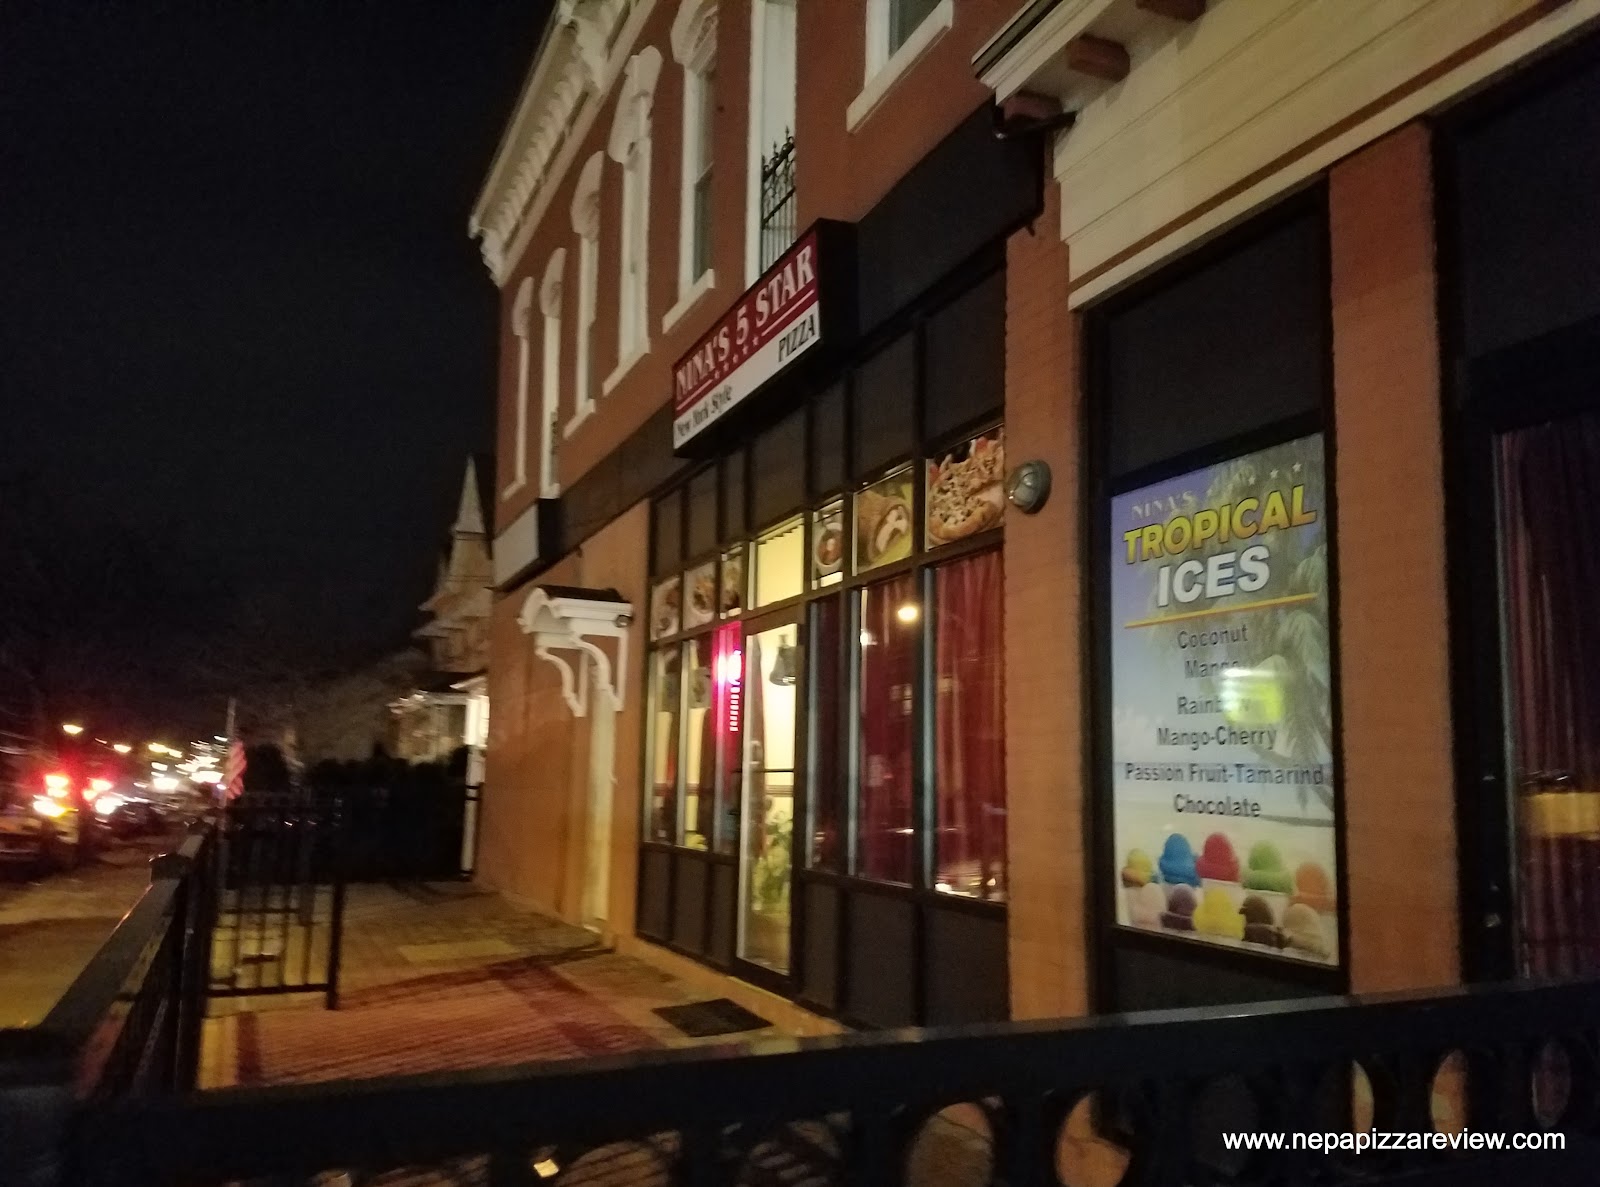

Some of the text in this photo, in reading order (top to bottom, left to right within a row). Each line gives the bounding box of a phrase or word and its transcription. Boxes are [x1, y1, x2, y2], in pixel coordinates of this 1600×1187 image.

[675, 244, 816, 399] NINA'S 5 STAR
[777, 313, 817, 363] PIZZA
[1122, 484, 1318, 565] TROPICAL
[1156, 544, 1272, 608] ICES
[1177, 623, 1249, 650] Coconut
[1157, 725, 1278, 751] Mango-Cherry
[1125, 761, 1324, 785] Passion Fruit-Tamarind
[1174, 792, 1262, 818] Chocolate
